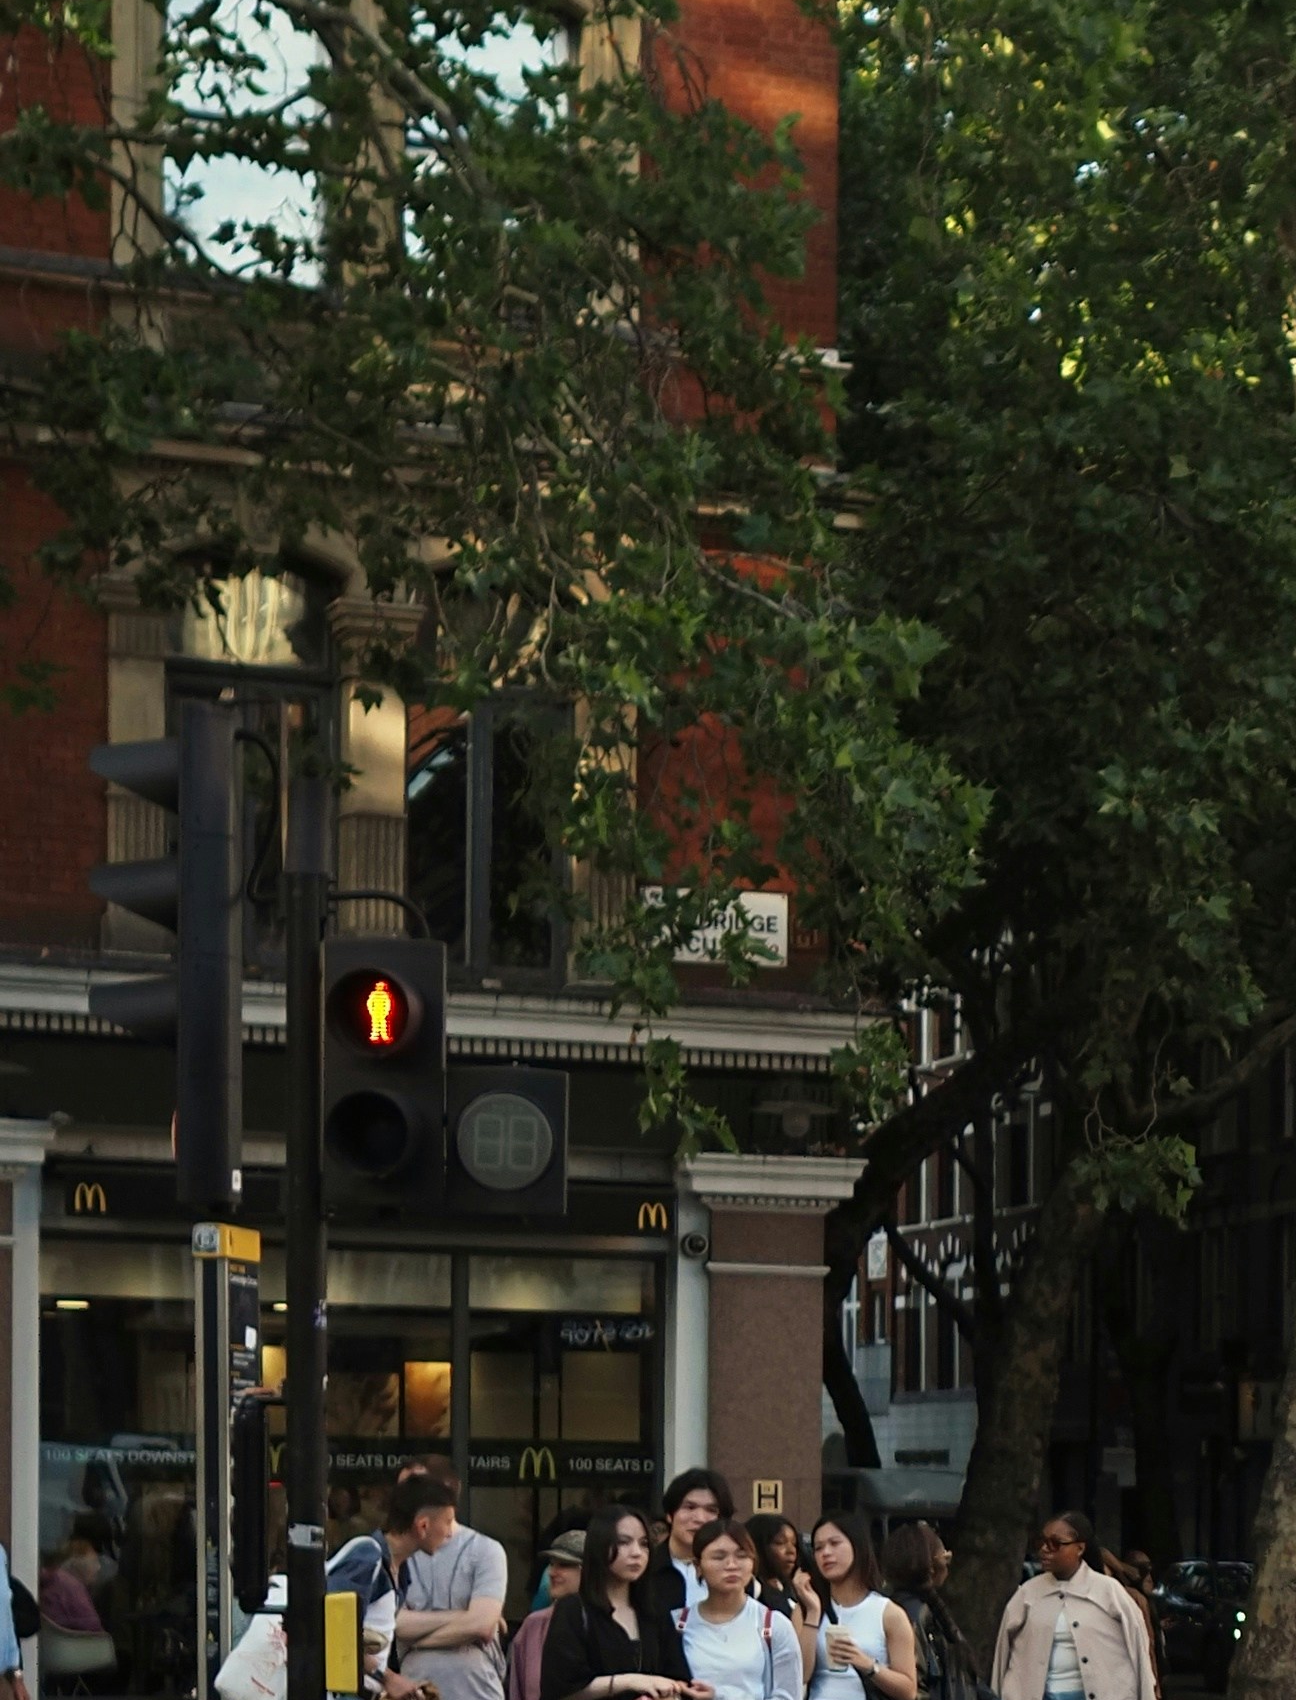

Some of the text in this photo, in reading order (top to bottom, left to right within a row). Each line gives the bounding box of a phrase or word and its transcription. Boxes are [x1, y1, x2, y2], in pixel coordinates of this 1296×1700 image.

[128, 1450, 196, 1464] DOWNST
[336, 1454, 383, 1468] SEATS
[470, 1456, 511, 1470] TAIRS
[569, 1458, 593, 1471] 100
[595, 1458, 640, 1472] SEATS
